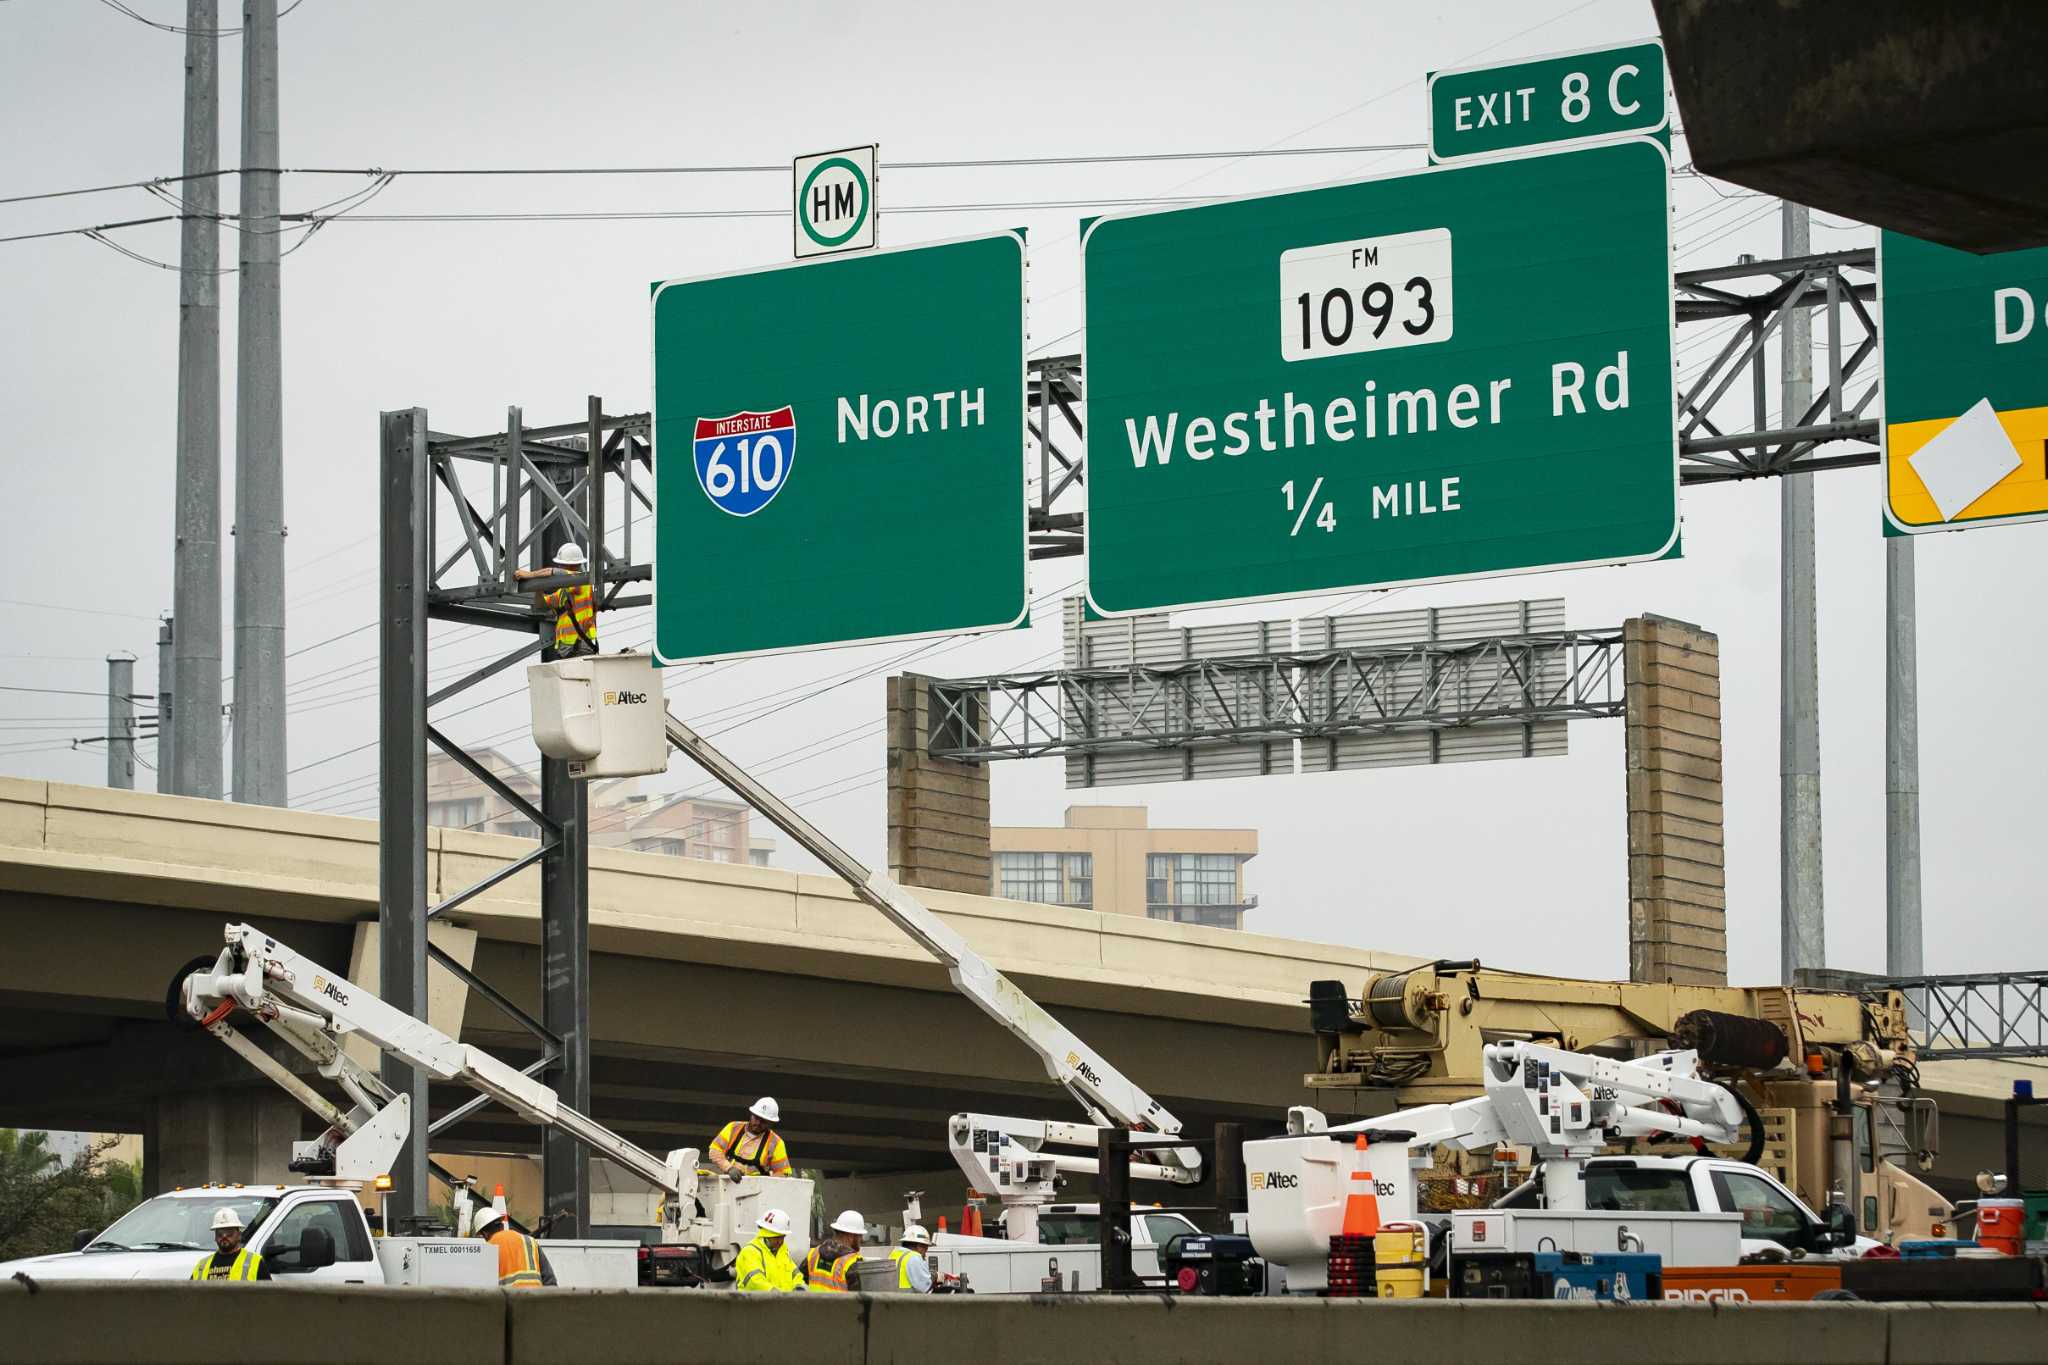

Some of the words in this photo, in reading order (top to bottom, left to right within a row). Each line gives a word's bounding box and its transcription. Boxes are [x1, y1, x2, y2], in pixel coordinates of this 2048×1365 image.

[1455, 87, 1536, 132] EXIT
[813, 181, 854, 224] HM
[1352, 246, 1378, 269] FM
[1297, 276, 1435, 350] 1093
[1994, 287, 2048, 345] D
[716, 415, 771, 435] INTERSTATE
[837, 387, 985, 444] NORTH
[1124, 378, 1512, 468] Westheimer
[1551, 350, 1629, 417] Rd
[706, 435, 783, 497] 610
[1372, 476, 1461, 519] MILE
[617, 691, 648, 705] Altec
[323, 982, 349, 1007] Altec
[1075, 1061, 1102, 1087] Altec
[1266, 1171, 1298, 1189] Altec
